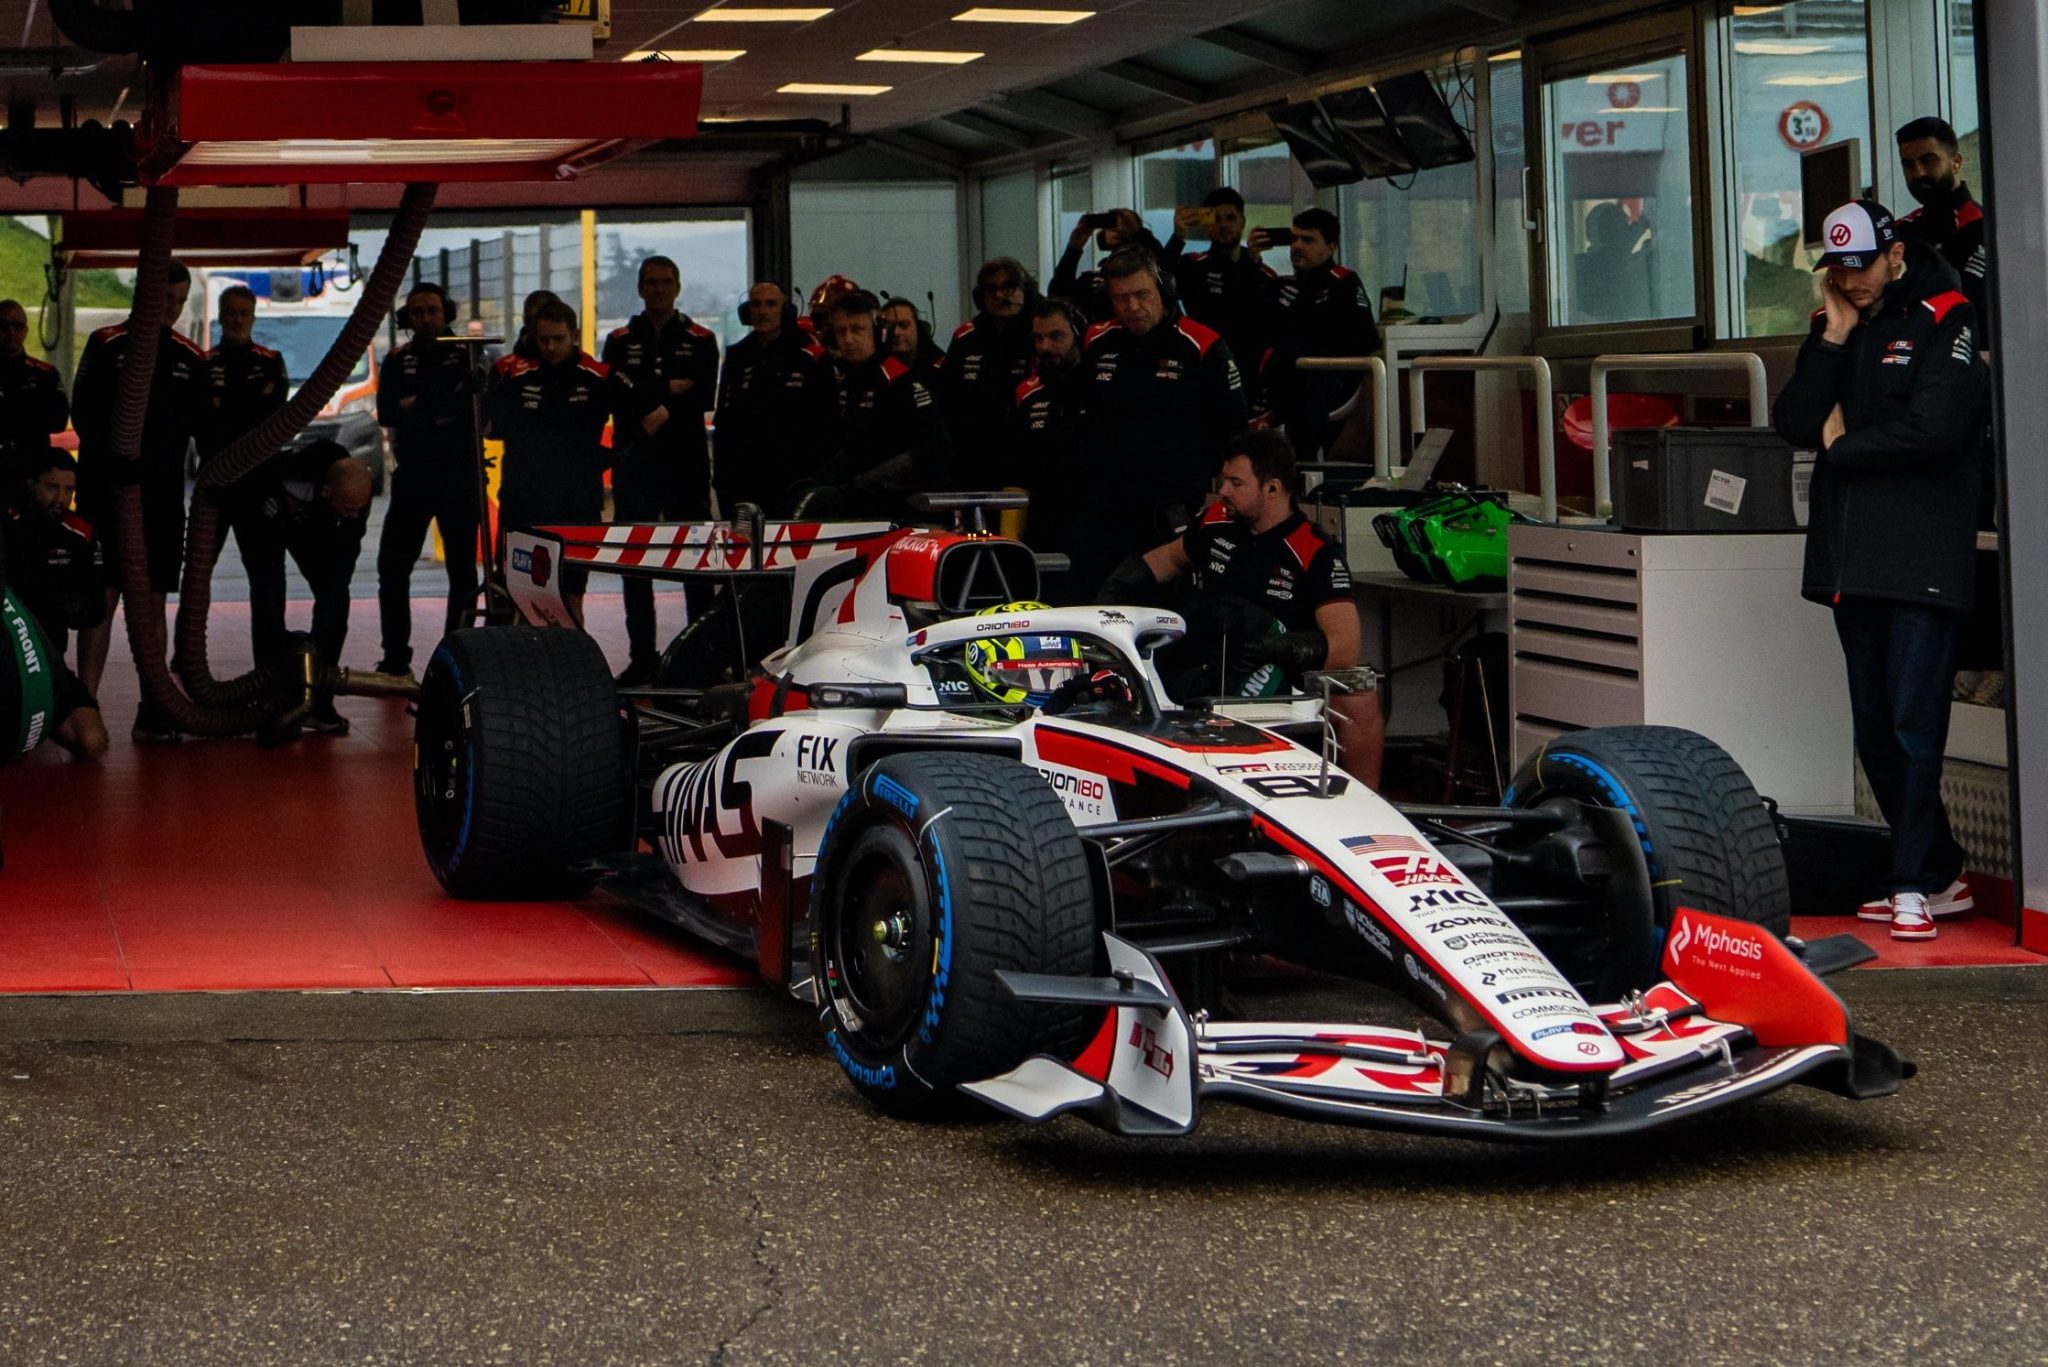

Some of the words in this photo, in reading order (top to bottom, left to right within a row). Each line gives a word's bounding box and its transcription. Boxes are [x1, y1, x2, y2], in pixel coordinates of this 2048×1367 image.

[976, 620, 1030, 632] ORION180
[11, 616, 41, 675] FRONT
[797, 734, 839, 772] FIX
[797, 770, 839, 788] NETWORK
[872, 773, 920, 819] PIRELLI
[1402, 872, 1454, 885] HAAS
[1425, 916, 1513, 934] ZOOMEX
[1471, 939, 1531, 949] Medicine
[1693, 922, 1763, 961] Mphasis
[1691, 954, 1706, 967] The
[1708, 959, 1727, 972] Next
[1729, 964, 1761, 981] Applied
